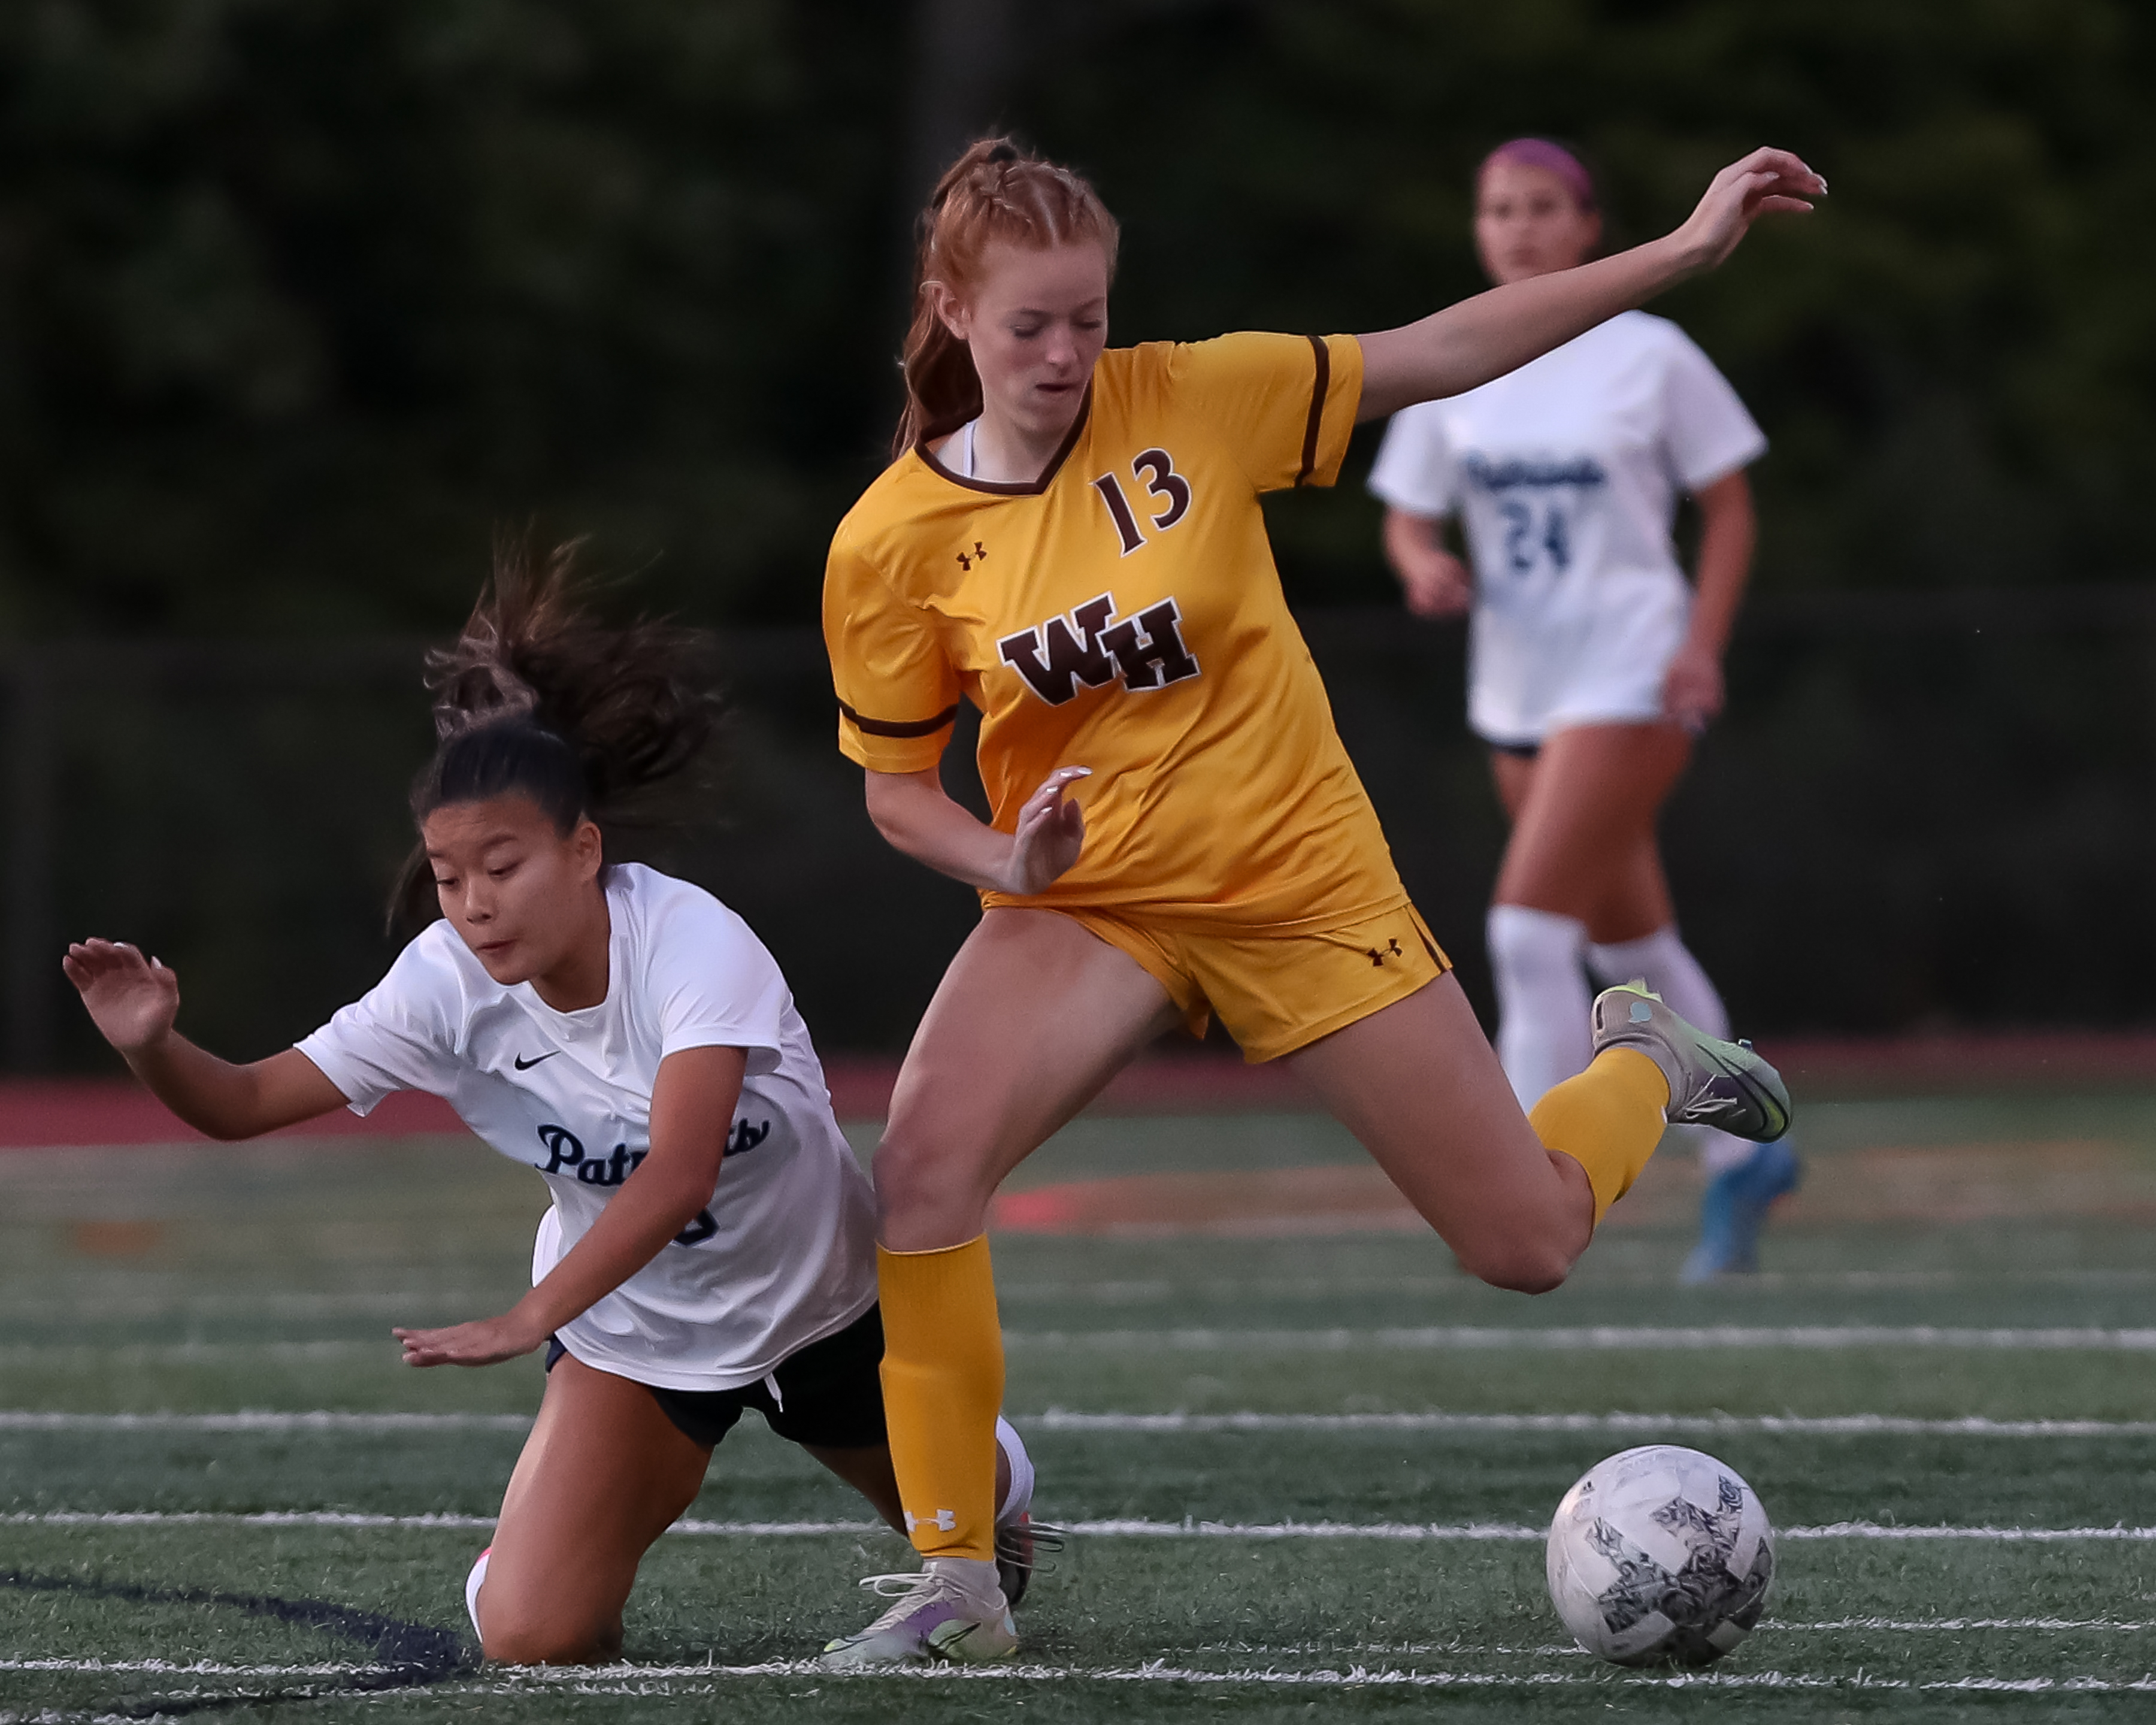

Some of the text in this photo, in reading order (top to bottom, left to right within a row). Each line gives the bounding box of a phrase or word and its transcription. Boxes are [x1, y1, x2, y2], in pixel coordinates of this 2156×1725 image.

[1089, 447, 1191, 558] 13
[997, 591, 1201, 707] WH
[534, 1118, 771, 1186] Patts
